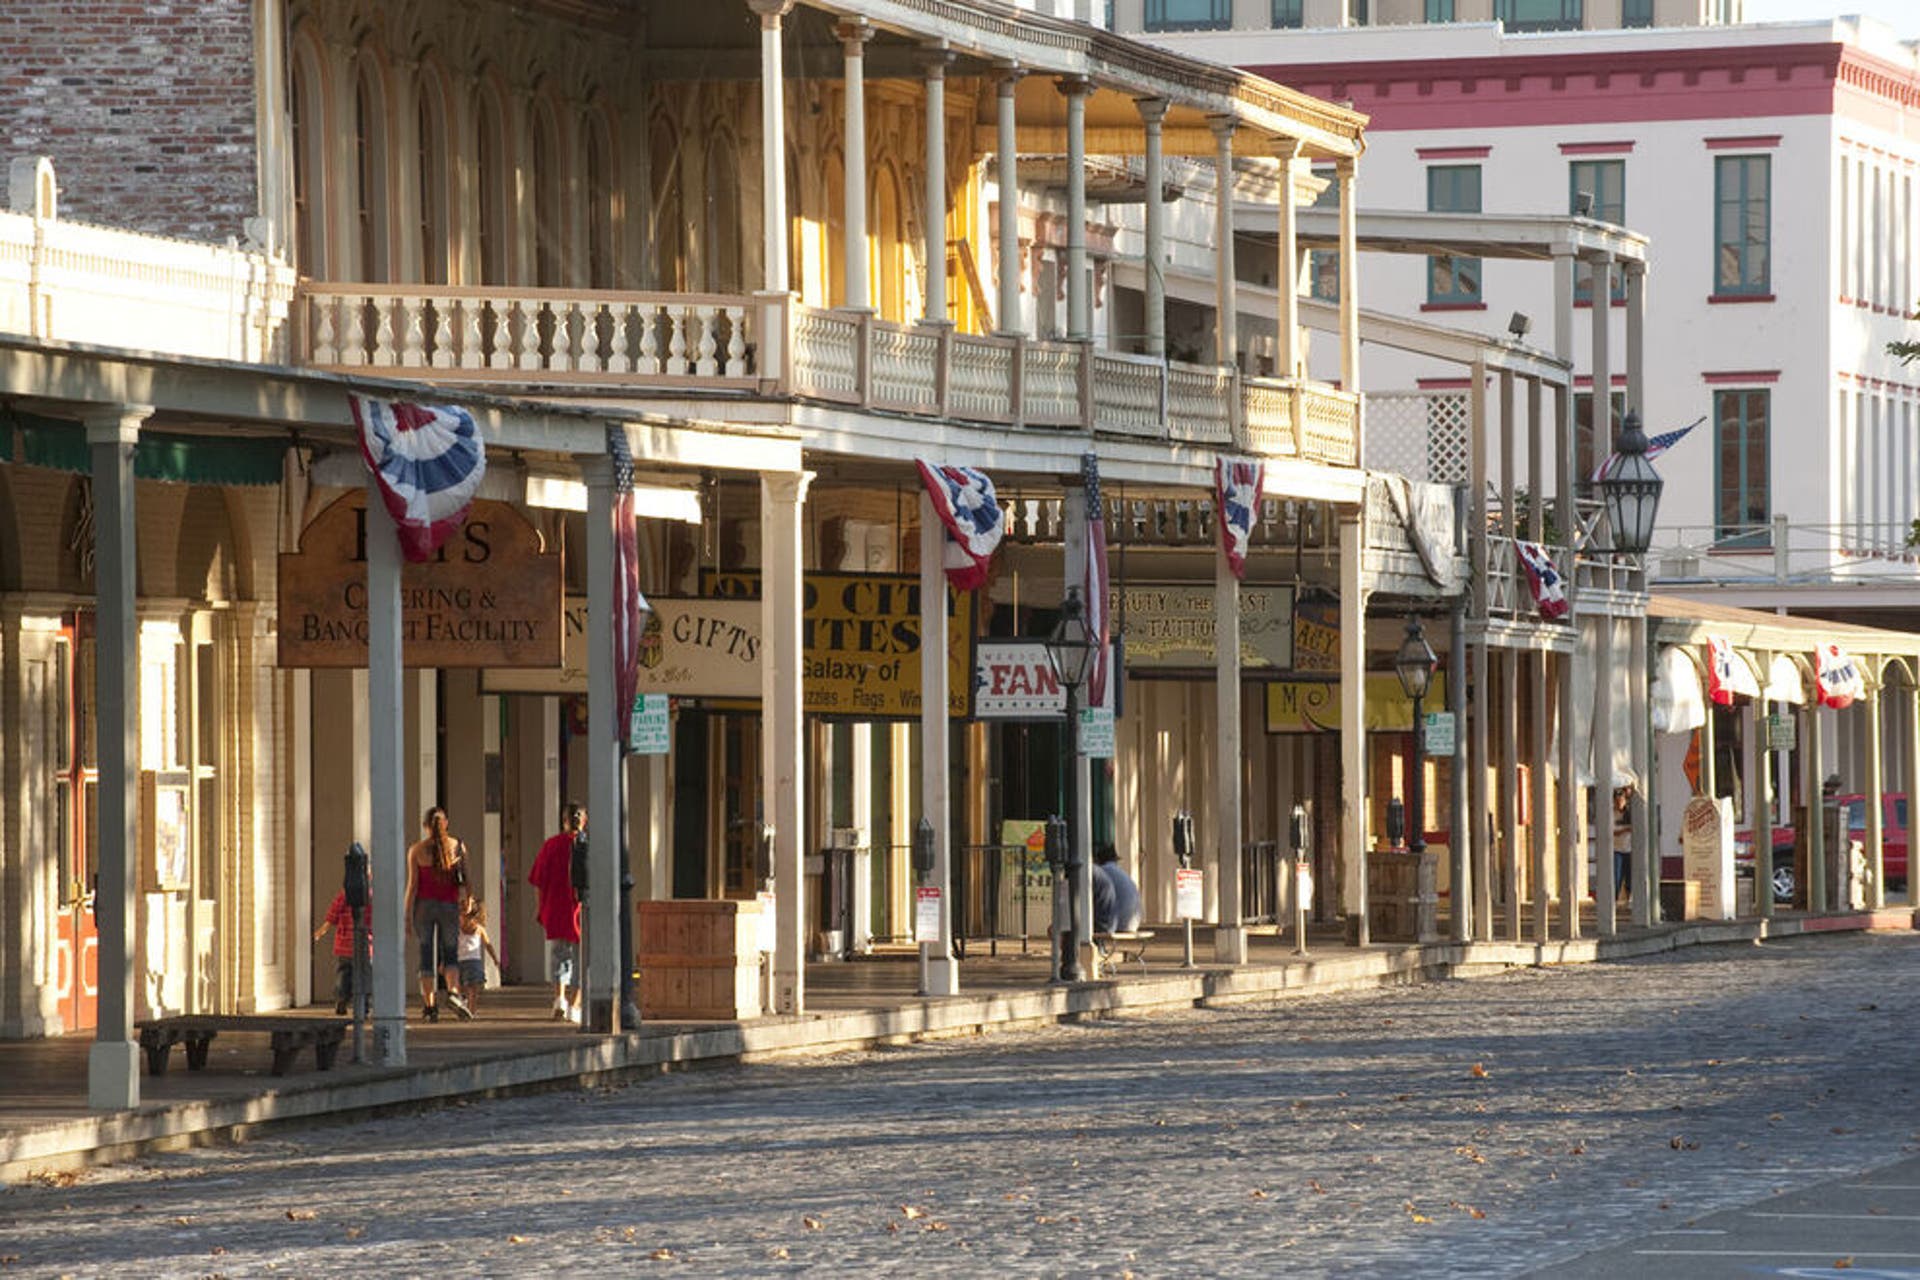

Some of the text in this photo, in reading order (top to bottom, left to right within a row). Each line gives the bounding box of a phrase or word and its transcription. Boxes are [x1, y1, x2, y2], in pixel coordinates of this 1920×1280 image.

[344, 582, 496, 609] CERING &
[303, 613, 423, 645] BANQT
[426, 613, 540, 642] FACILITY
[672, 613, 761, 662] GIFTS
[803, 618, 921, 654] ITES
[803, 656, 901, 683] Galaxy of
